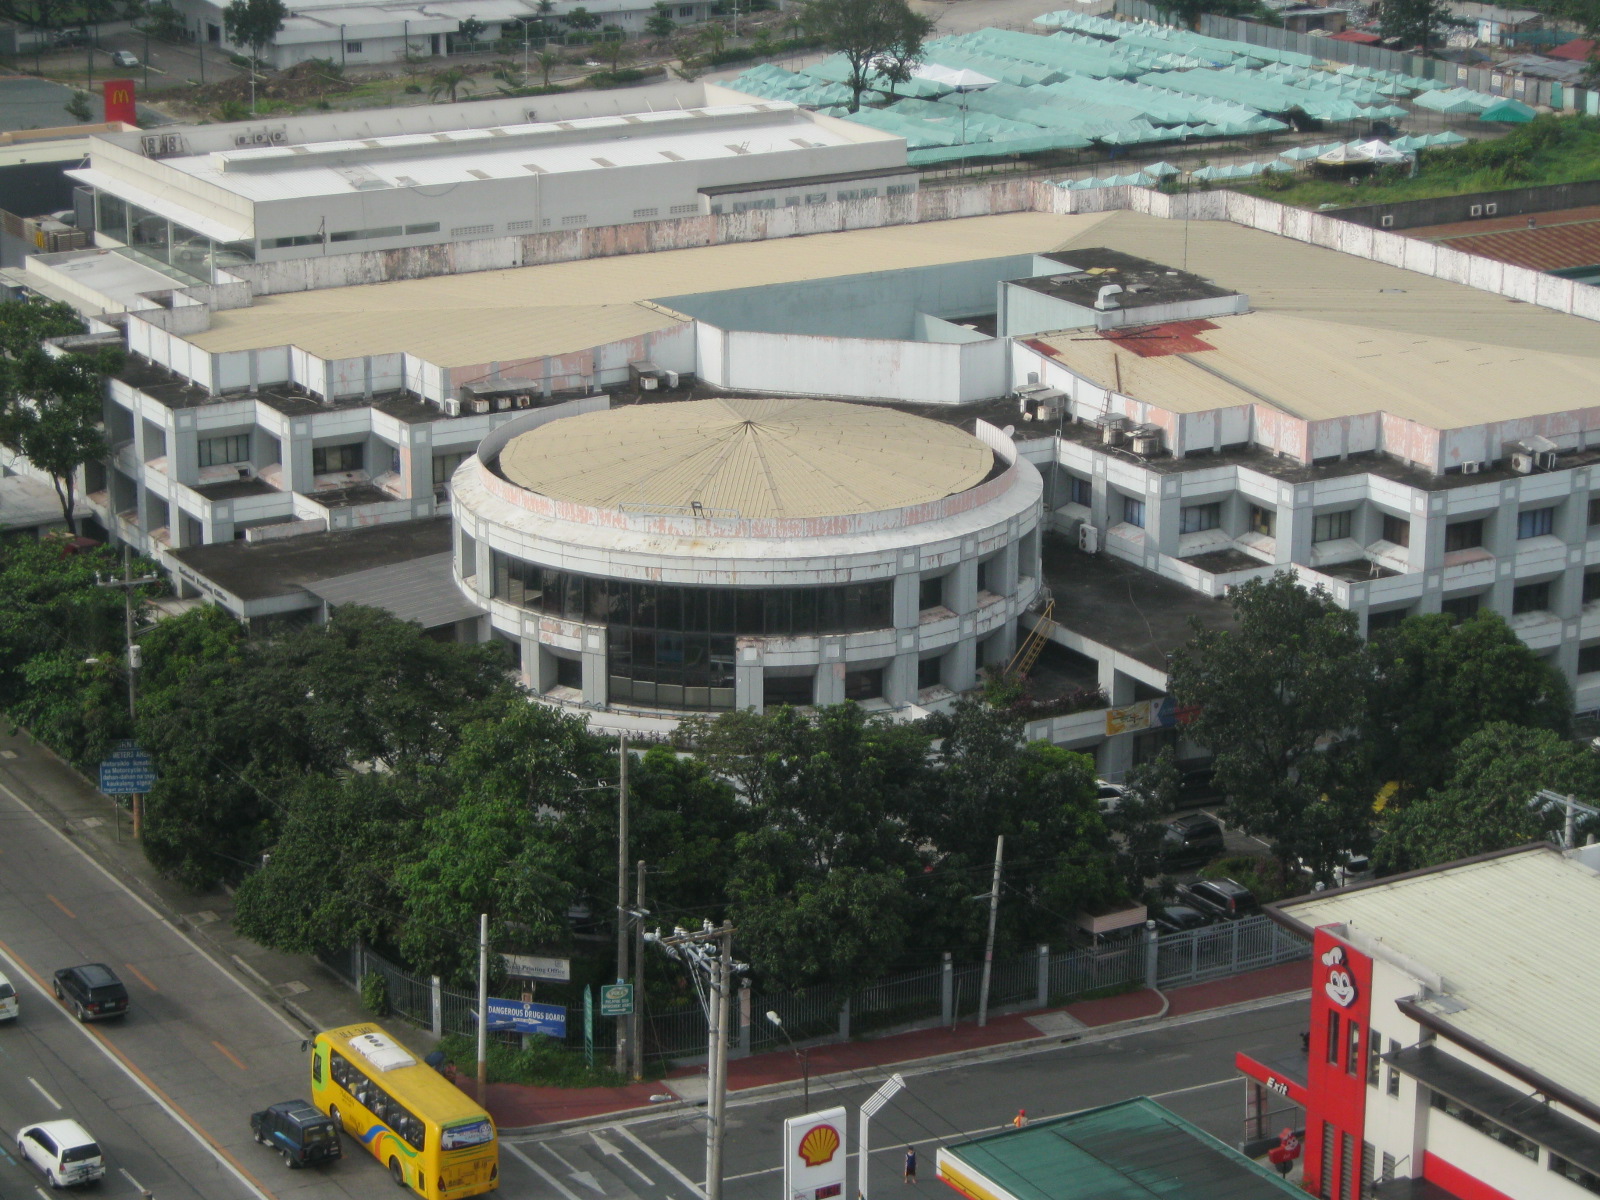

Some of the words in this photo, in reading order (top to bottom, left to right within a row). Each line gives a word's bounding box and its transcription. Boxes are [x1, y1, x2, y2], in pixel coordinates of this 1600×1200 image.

[522, 964, 546, 973] Printing
[488, 1005, 523, 1017] DANGEROUS
[524, 1010, 545, 1020] DRUGS
[545, 1012, 566, 1022] BOARD
[1266, 1076, 1288, 1096] Exit
